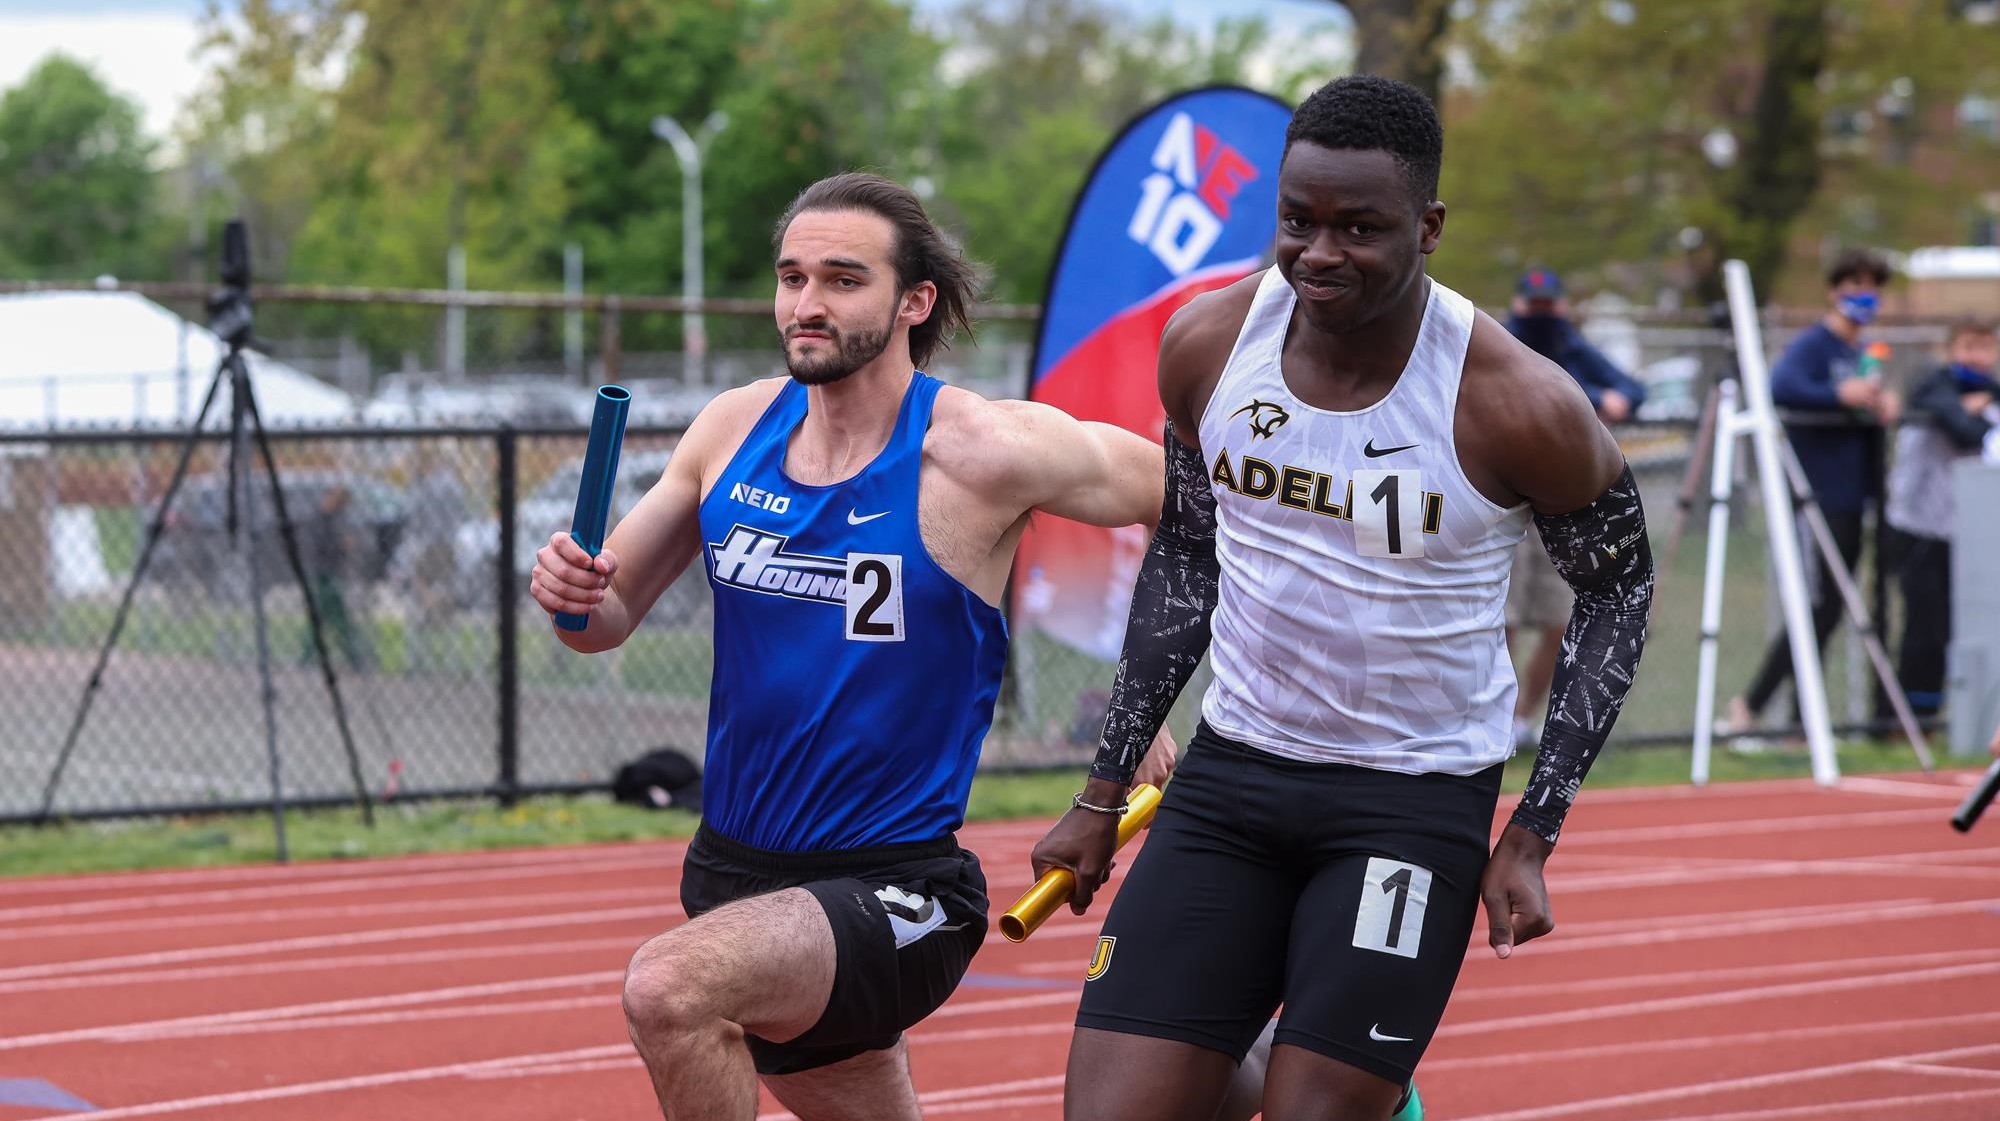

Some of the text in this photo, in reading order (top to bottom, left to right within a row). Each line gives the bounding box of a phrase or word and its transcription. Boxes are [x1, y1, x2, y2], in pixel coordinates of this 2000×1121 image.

[1152, 111, 1260, 221] NE
[1127, 172, 1224, 279] 10
[729, 482, 791, 514] NE10
[1212, 447, 1443, 534] ADELI
[1370, 475, 1402, 554] 1
[852, 559, 895, 636] 2
[1381, 868, 1413, 949] 1
